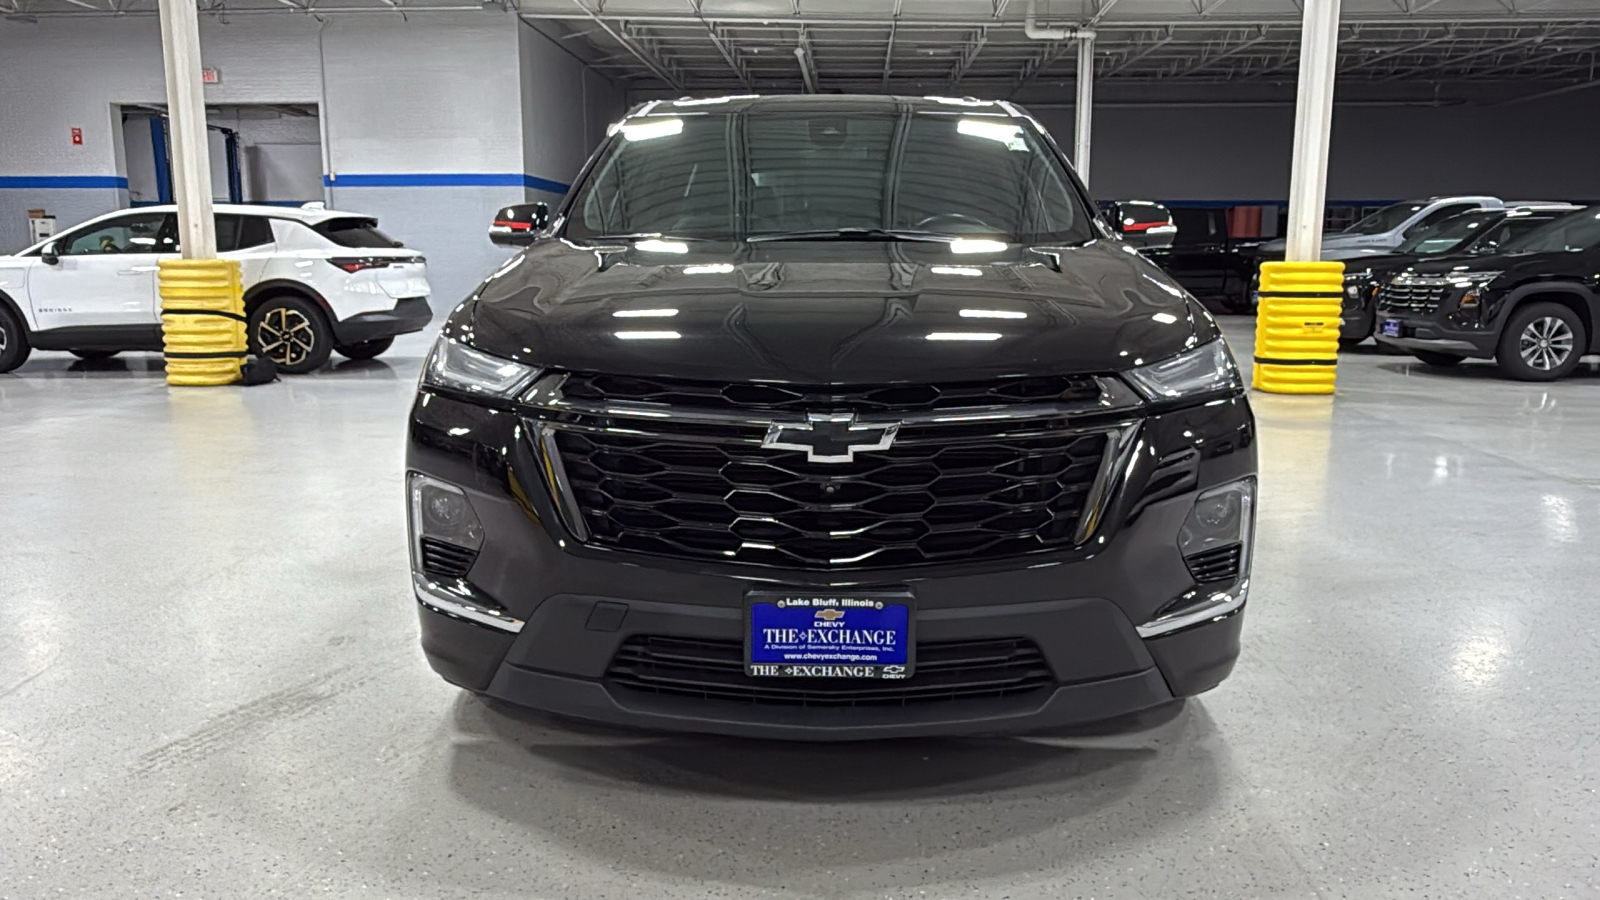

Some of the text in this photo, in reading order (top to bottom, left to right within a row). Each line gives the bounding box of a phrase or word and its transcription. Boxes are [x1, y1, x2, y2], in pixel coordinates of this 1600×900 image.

[786, 598, 874, 607] Lake Bluff, Illinois
[763, 629, 896, 645] THE EXCHANGE
[784, 653, 877, 661] www.chevyexchange.com
[750, 665, 874, 676] THE EXCHANGE
